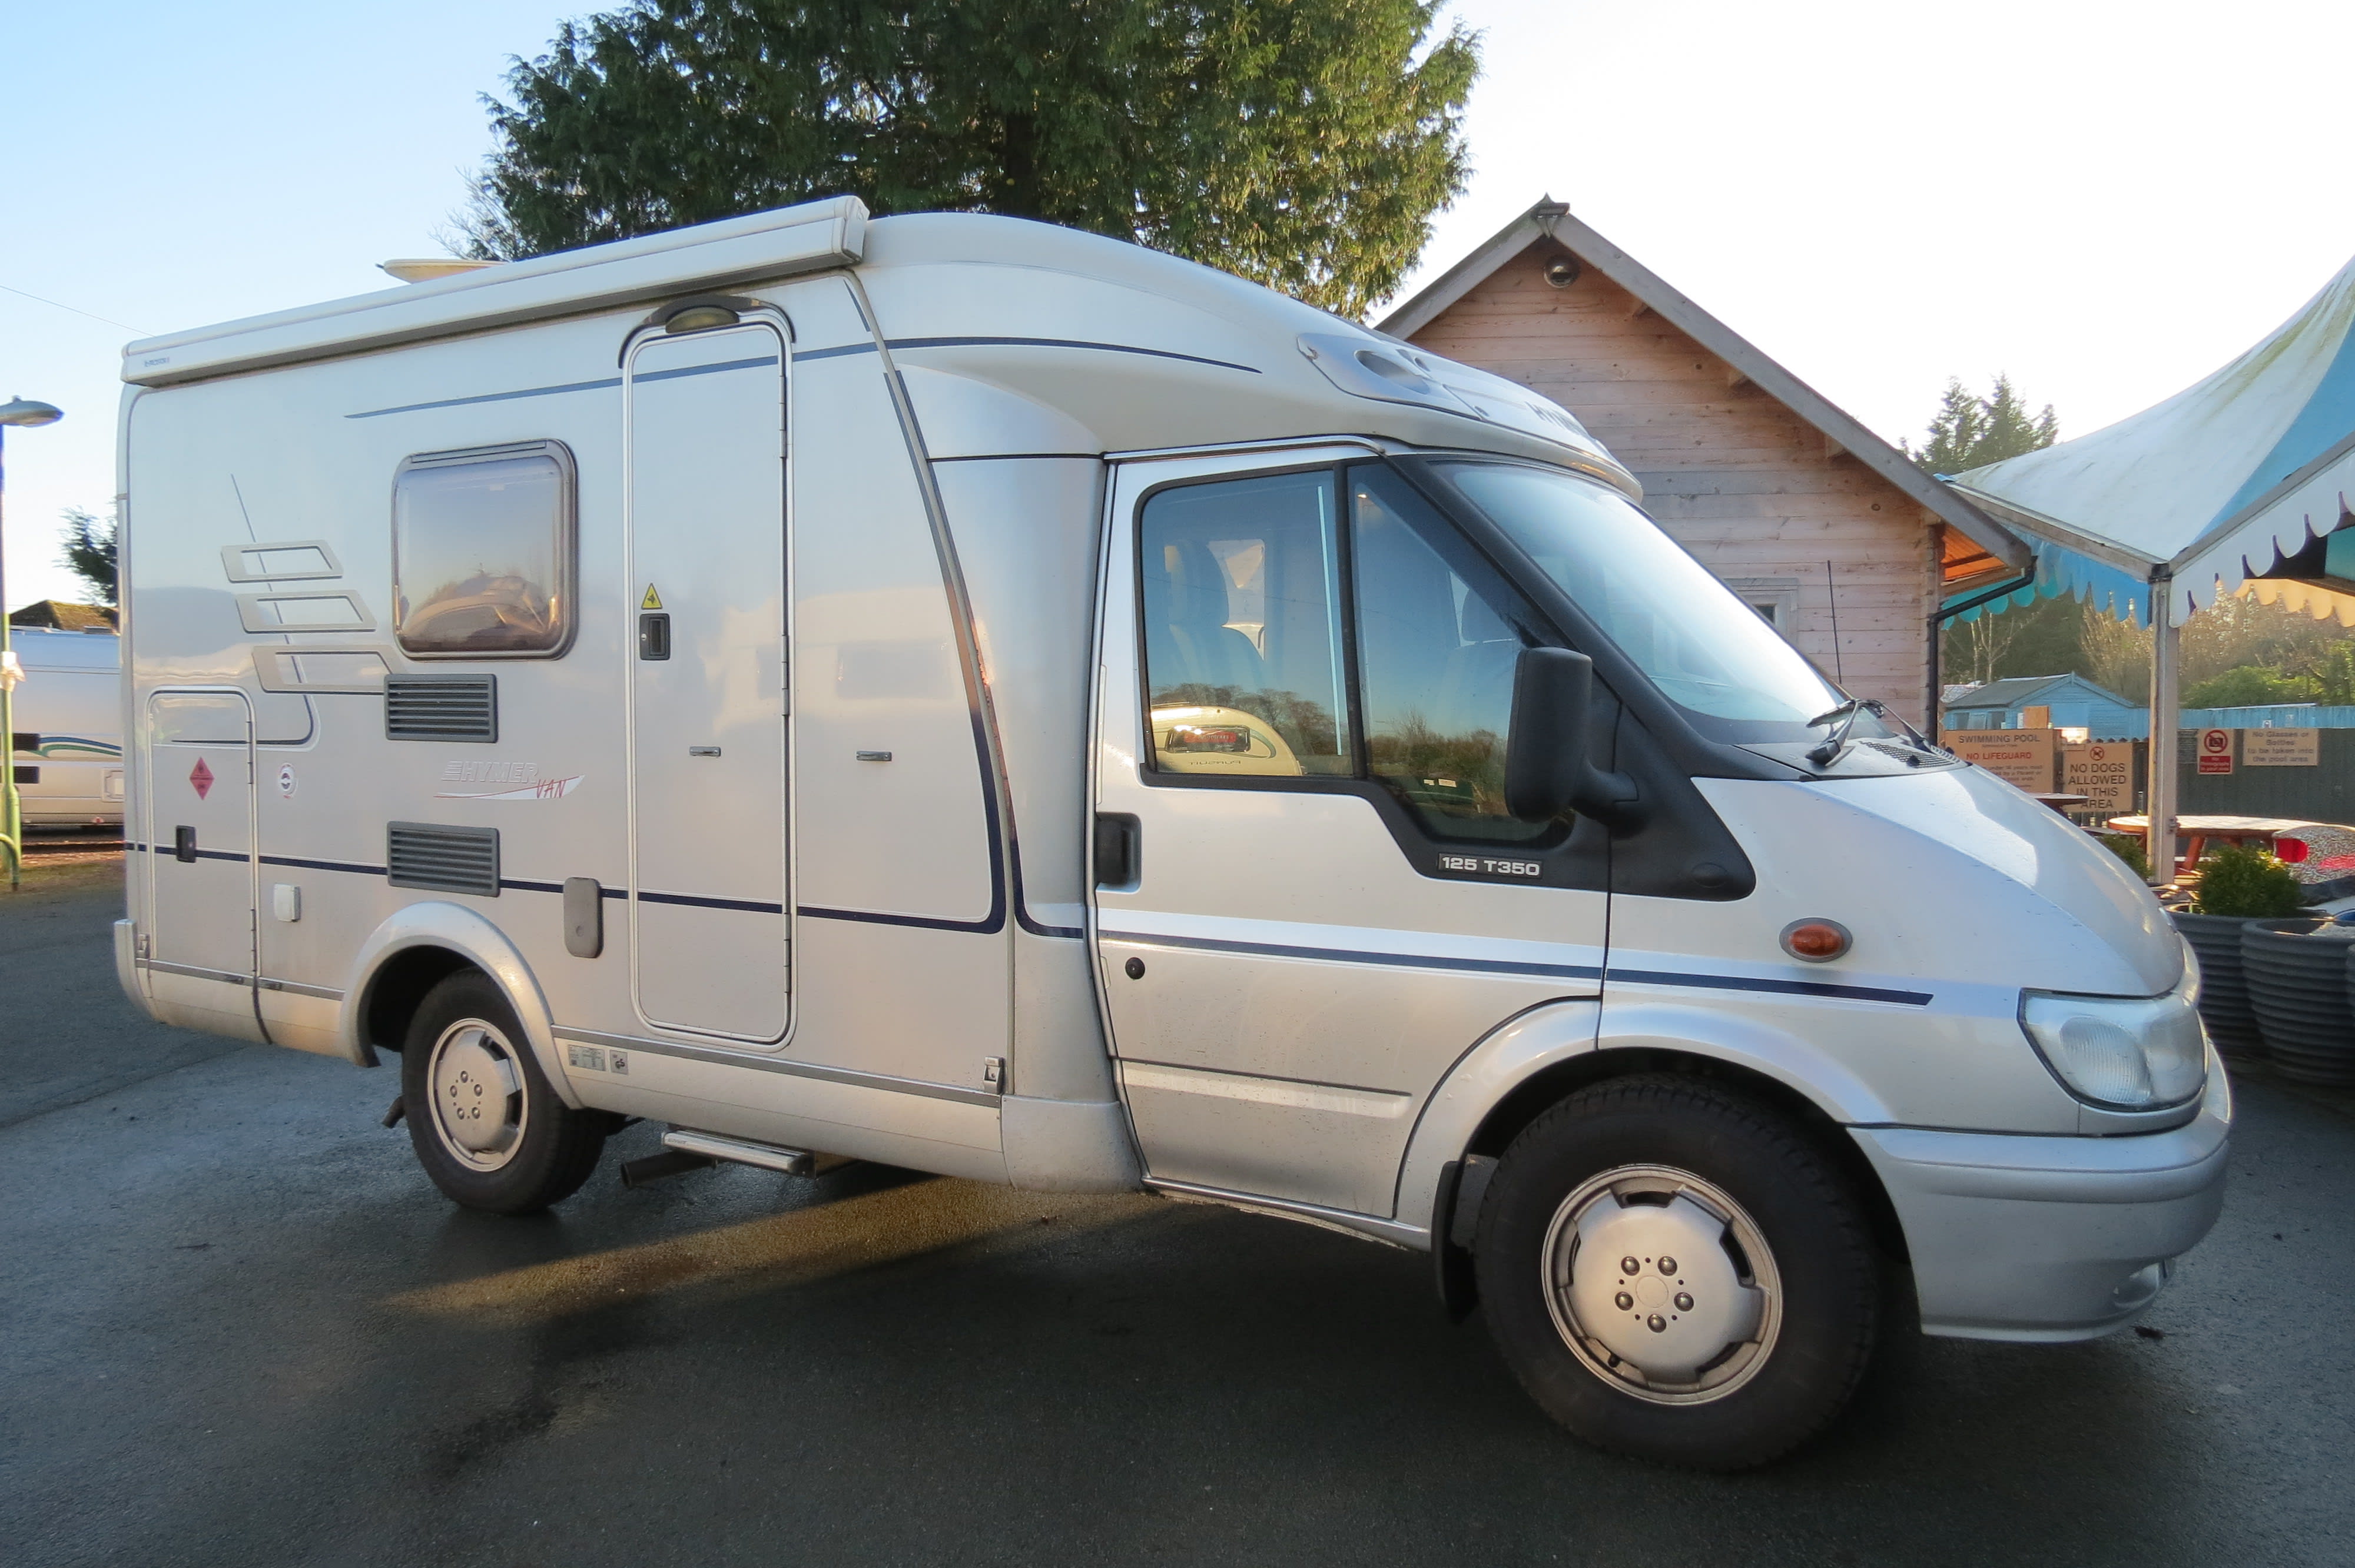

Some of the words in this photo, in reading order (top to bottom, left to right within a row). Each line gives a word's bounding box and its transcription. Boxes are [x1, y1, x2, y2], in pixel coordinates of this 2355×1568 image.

[1959, 735, 2010, 743] SWIMMING
[2014, 734, 2041, 742] POOL
[1982, 752, 2032, 760] LIFEGUARD
[460, 760, 540, 784] HYMER
[2070, 763, 2087, 772] NO
[2091, 763, 2125, 772] DOGS
[2068, 775, 2126, 785] ALLOWED
[536, 779, 566, 799] VAN
[2077, 788, 2088, 796] IN
[2091, 787, 2118, 796] THIS
[2081, 799, 2114, 809] AREA
[1442, 857, 1477, 872] 125
[1484, 859, 1540, 876] T350
